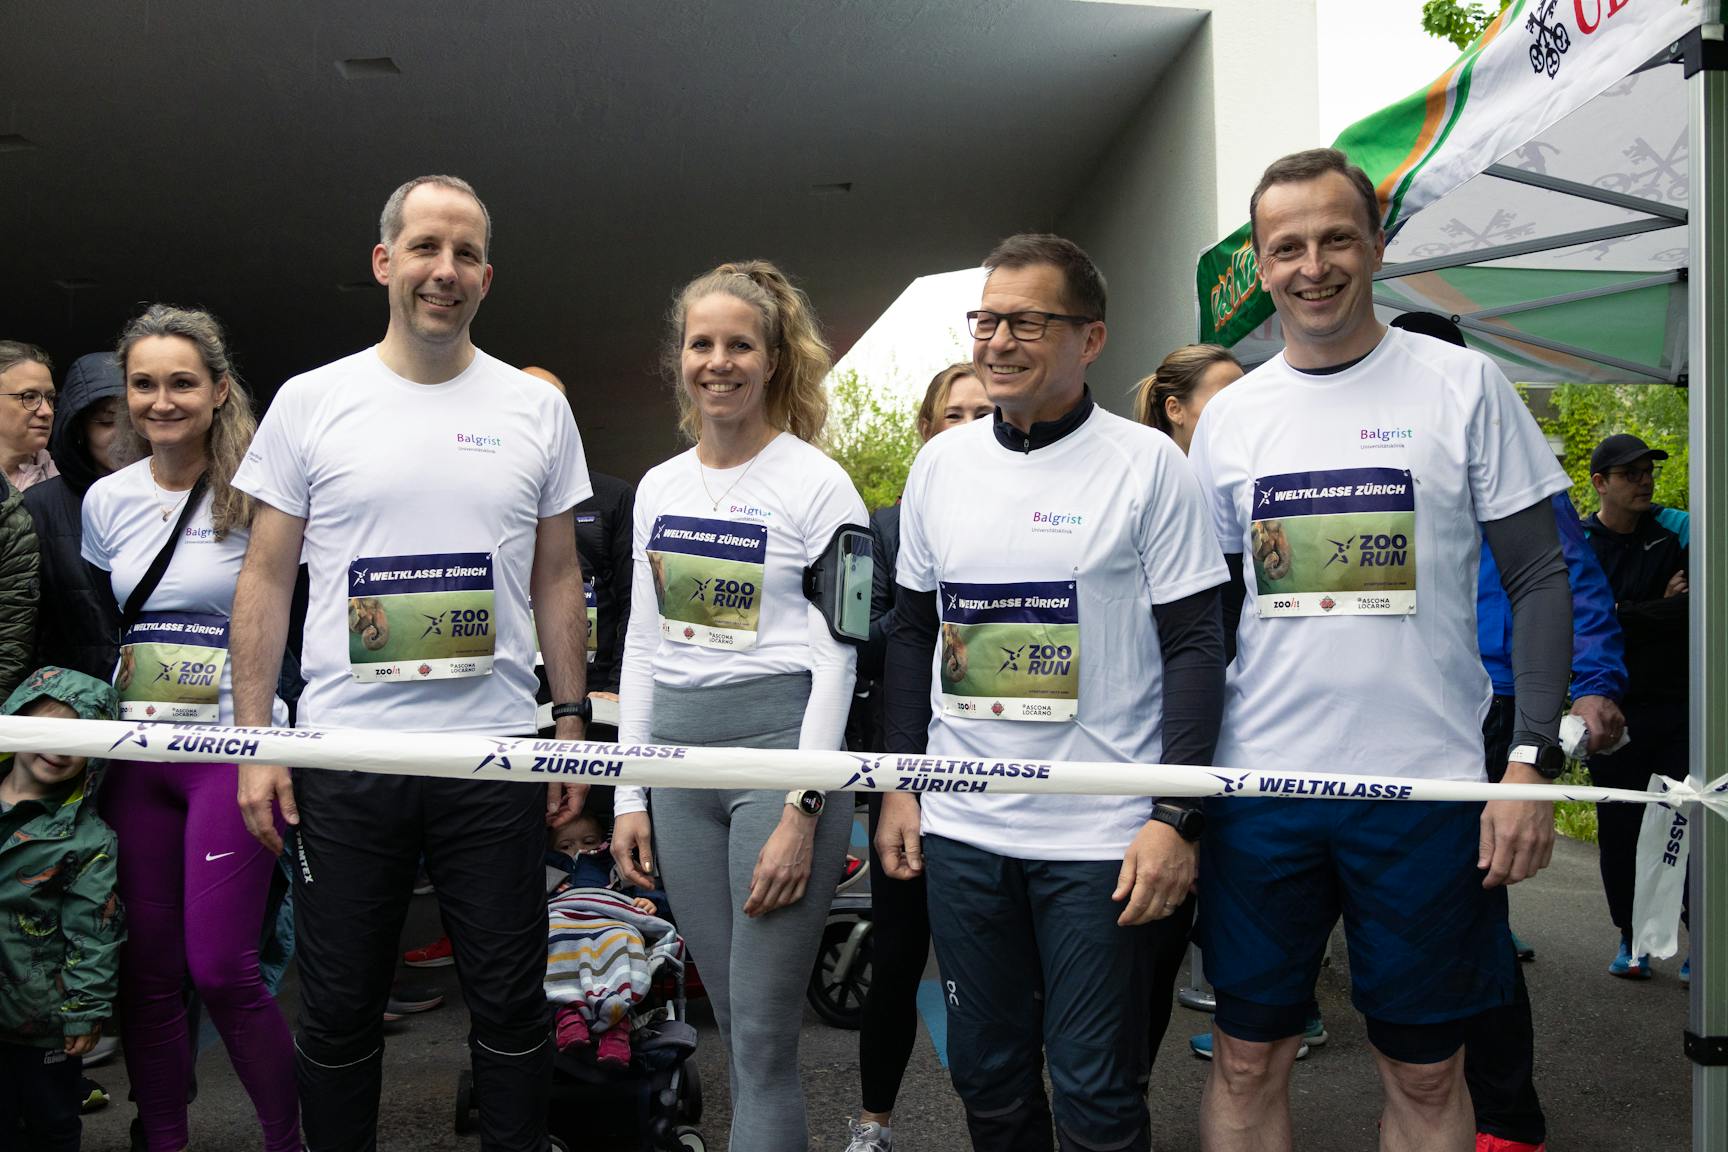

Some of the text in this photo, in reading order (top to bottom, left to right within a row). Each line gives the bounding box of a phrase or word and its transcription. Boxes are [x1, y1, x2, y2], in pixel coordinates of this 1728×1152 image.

[457, 433, 501, 446] Balgrist
[1360, 427, 1412, 441] Balgrist
[1274, 483, 1406, 501] WELTKLASSE ZÜRICH
[1033, 511, 1082, 526] Balgrist
[663, 528, 760, 549] WELTKLASSE ZÜRICH
[1359, 534, 1407, 550] ZOO
[1359, 550, 1407, 566] RUN
[370, 566, 487, 581] WELTKLASSE ZÜRICH
[714, 578, 755, 595] ZOO
[713, 593, 753, 610] RUN
[959, 596, 1070, 610] WELTKLASSE ZÜRICH
[451, 609, 489, 623] ZOO
[133, 623, 224, 636] WELTKLASSE ZÜRICH
[451, 623, 489, 637] RUN
[1028, 644, 1072, 660] ZOO
[180, 661, 217, 675] ZOO
[1027, 660, 1071, 676] RUN
[177, 674, 214, 686] RUN
[167, 732, 260, 757] ZÜRICH
[532, 741, 688, 759] WELTKLASSE
[531, 754, 623, 777] ZÜRICH
[896, 757, 1051, 779] WELTKLASSE
[895, 774, 988, 793] ZÜRICH
[1259, 777, 1412, 800] WELTKLASSE
